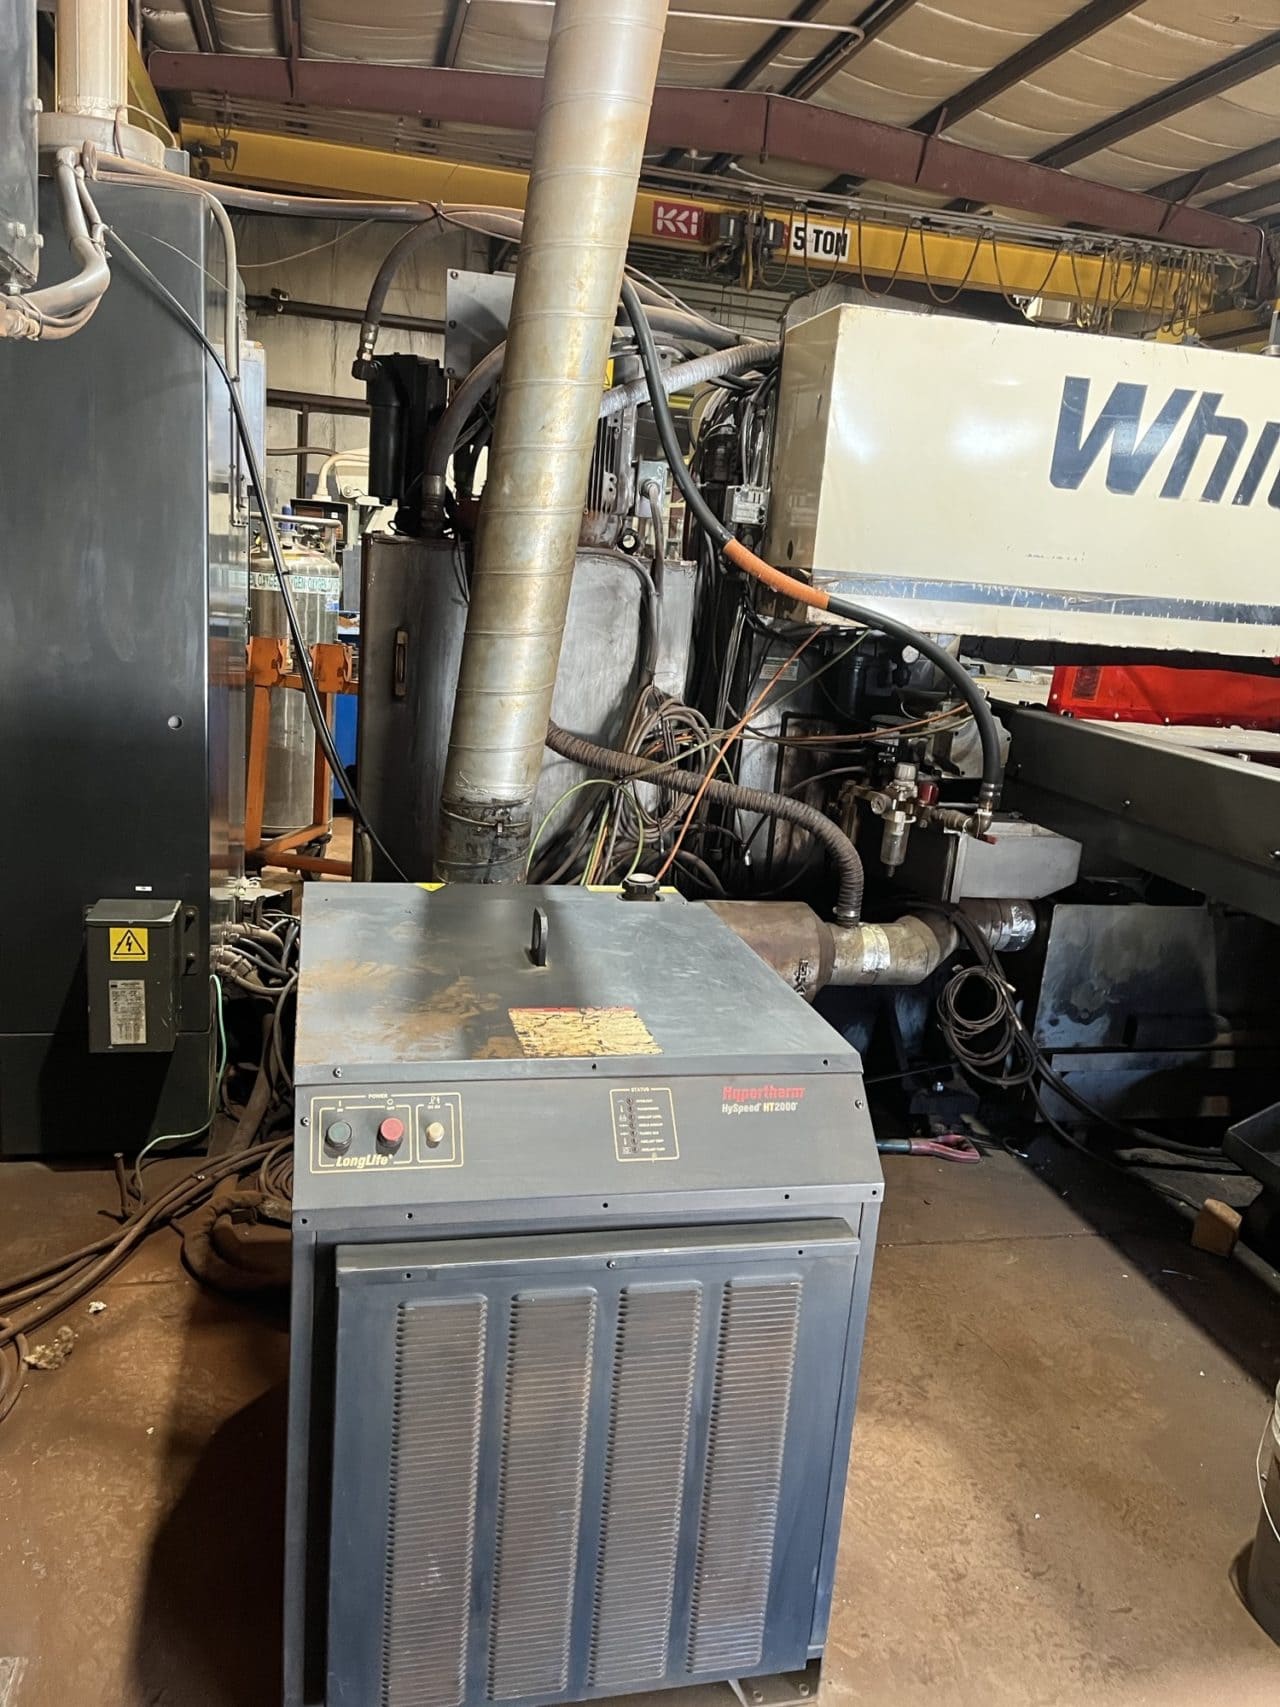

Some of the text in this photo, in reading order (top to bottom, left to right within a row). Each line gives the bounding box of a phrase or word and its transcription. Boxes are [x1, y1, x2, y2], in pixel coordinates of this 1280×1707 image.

[793, 226, 806, 251] 5
[813, 229, 848, 257] TON
[1050, 376, 1280, 509] Whi
[723, 1086, 805, 1102] Hypertherm
